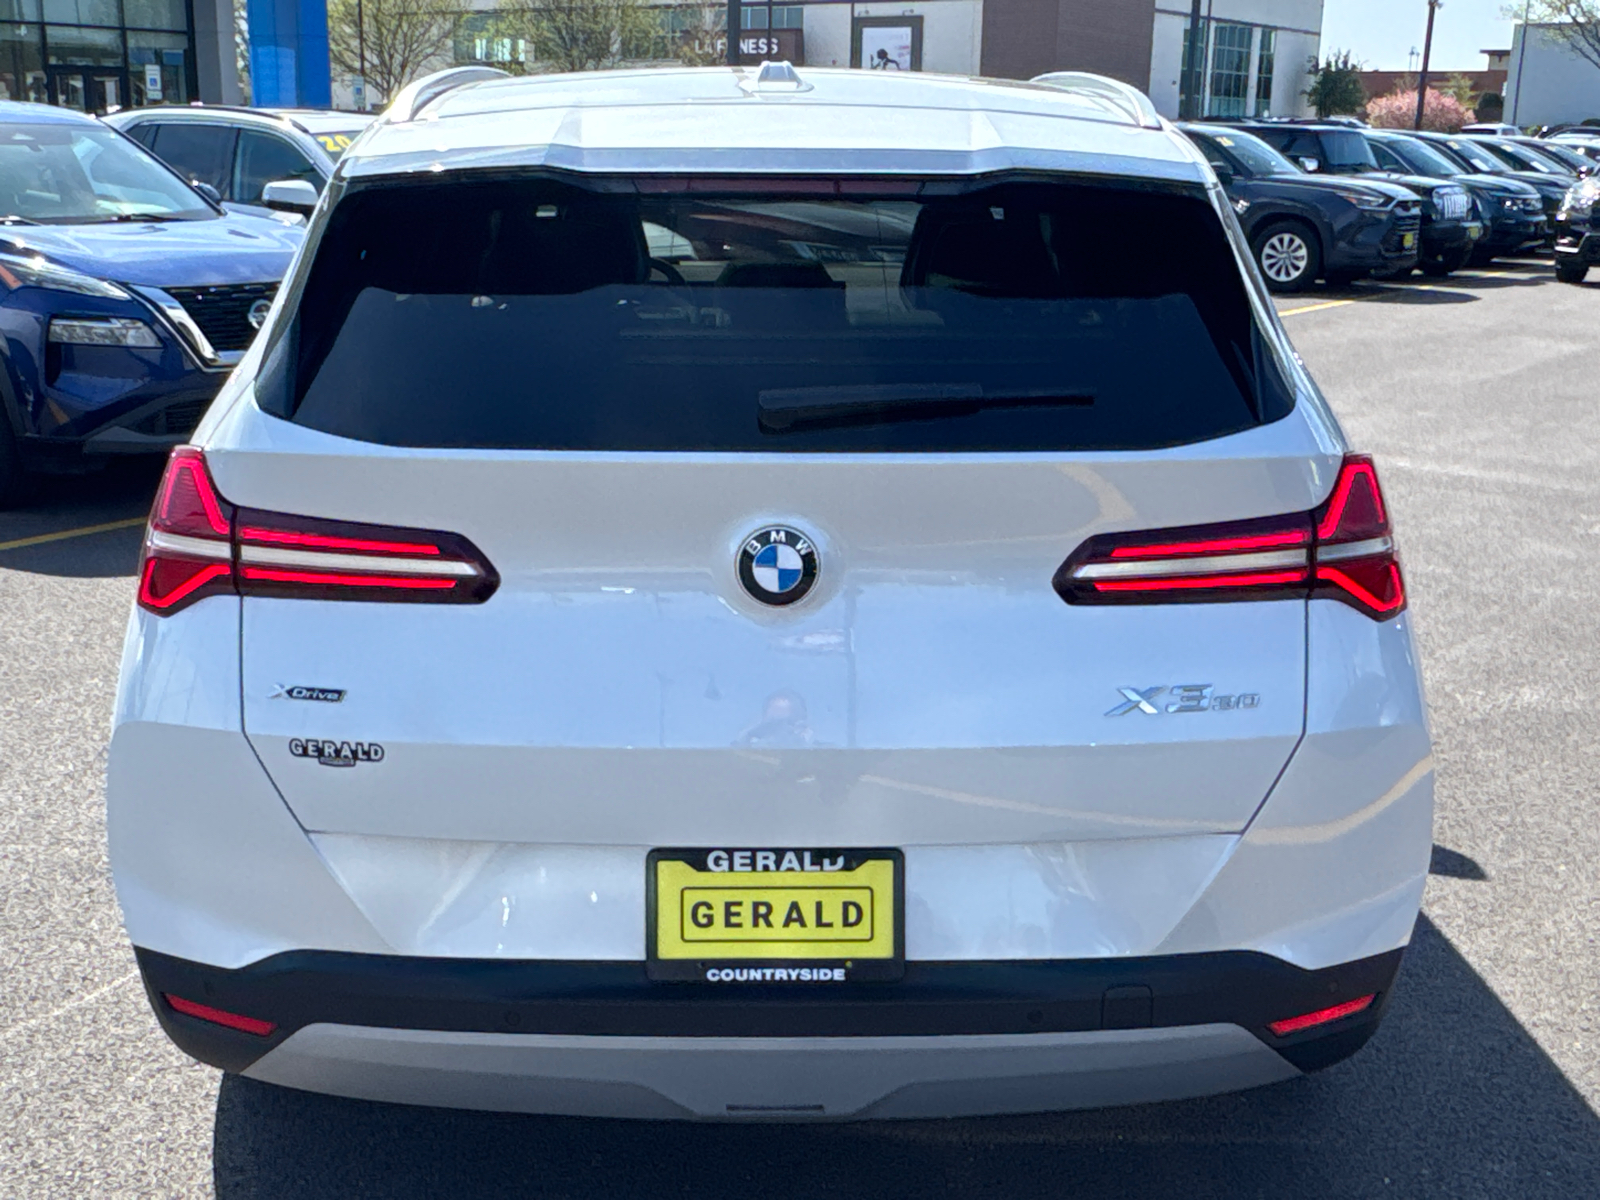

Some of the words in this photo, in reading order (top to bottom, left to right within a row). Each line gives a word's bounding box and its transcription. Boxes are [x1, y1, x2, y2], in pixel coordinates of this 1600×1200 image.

[716, 38, 779, 54] FNESS
[745, 530, 812, 556] BMW
[289, 738, 384, 762] GERALD
[706, 850, 845, 872] GERALD
[690, 901, 864, 929] GERALD
[706, 968, 846, 982] COUNTRYSIDE
